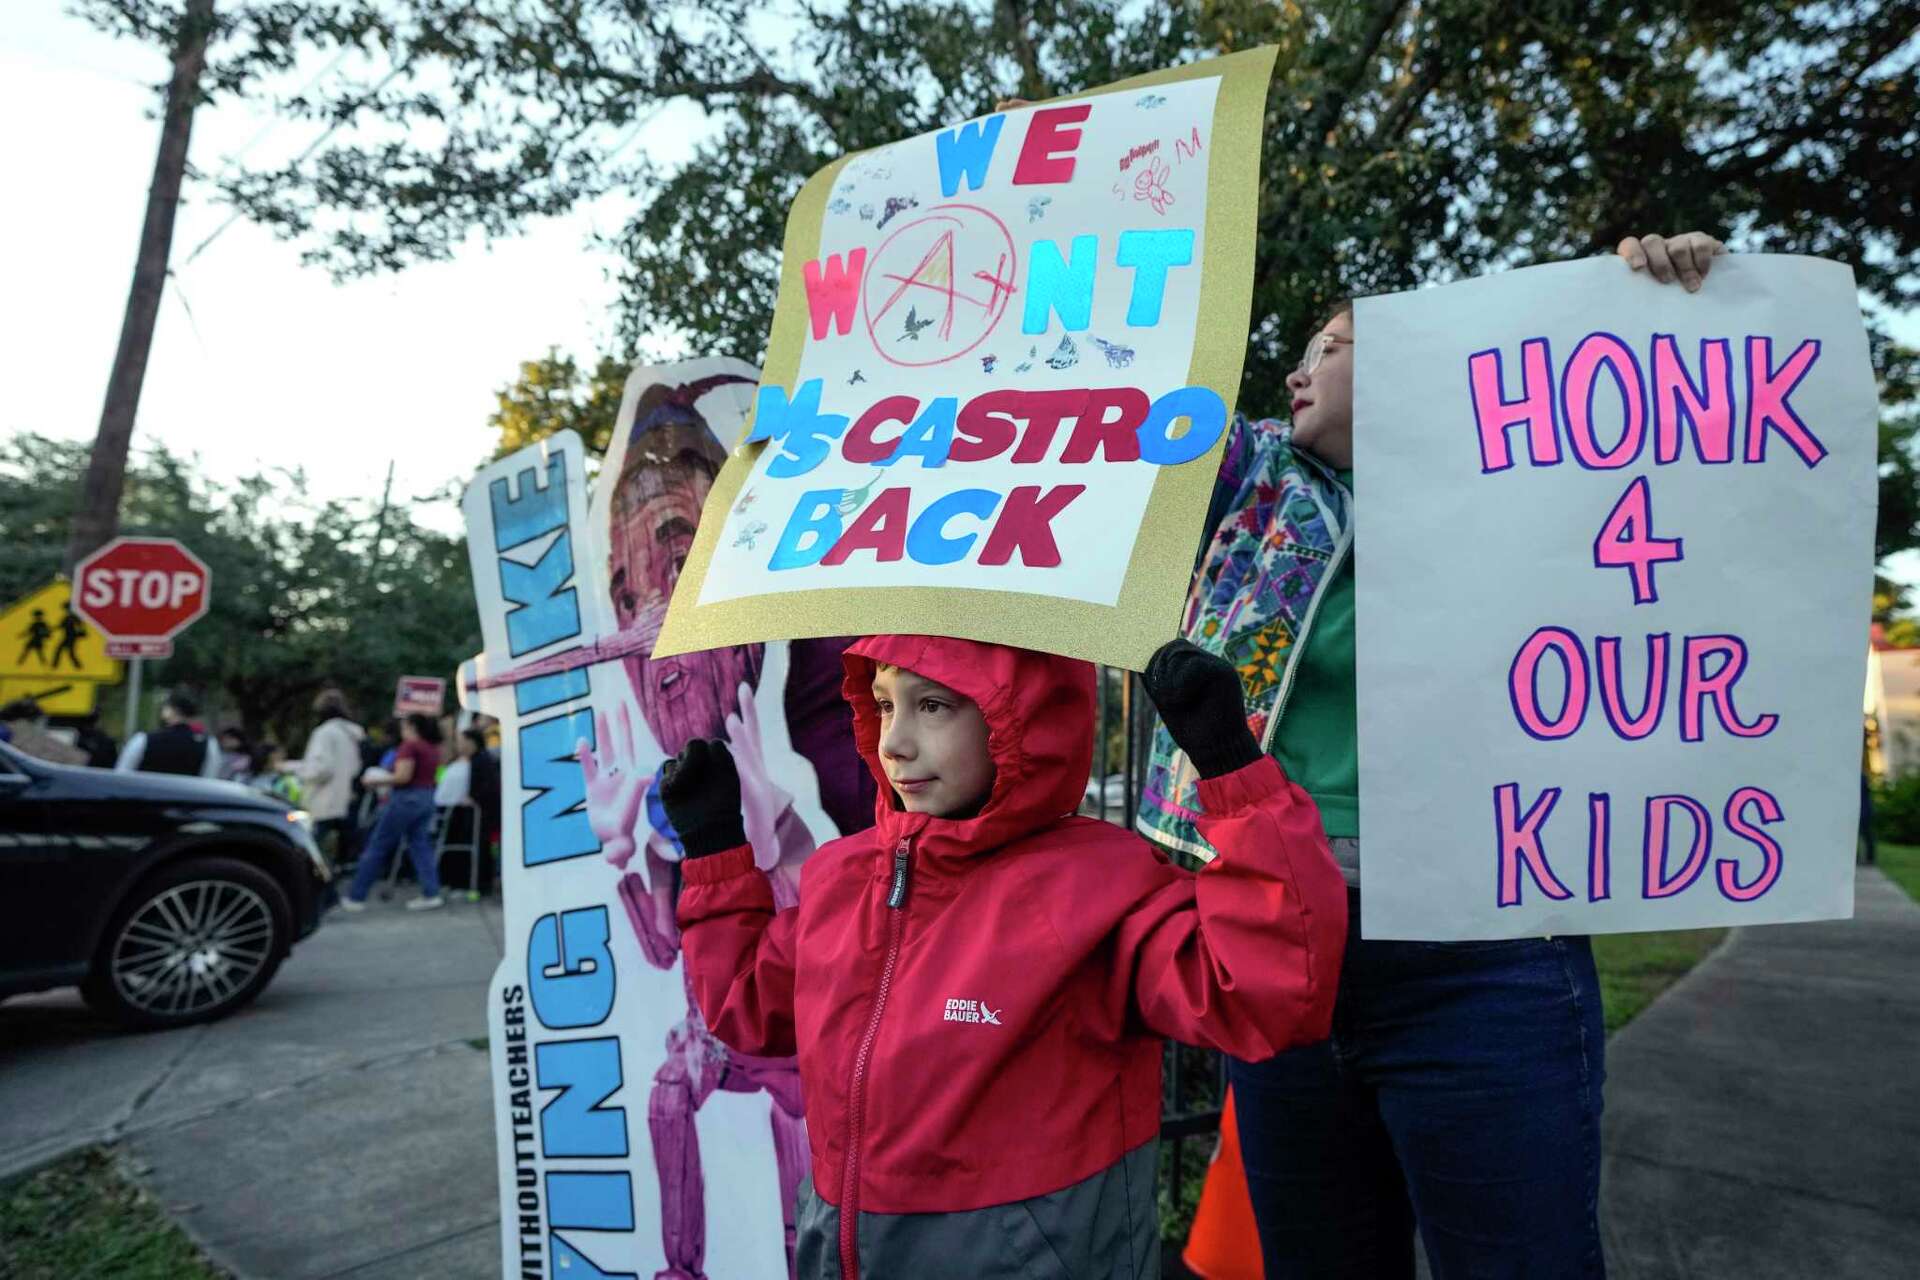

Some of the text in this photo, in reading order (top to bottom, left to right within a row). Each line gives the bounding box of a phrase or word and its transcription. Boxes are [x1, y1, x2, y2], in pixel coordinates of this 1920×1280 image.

[936, 105, 1092, 197] WE
[842, 387, 1227, 468] CASTRO
[1468, 333, 1828, 473] HONK
[767, 484, 1086, 571] BACK
[1593, 475, 1683, 605] 4
[84, 567, 201, 609] STOP
[490, 449, 602, 867] MIKE
[1508, 626, 1779, 742] OUR
[1493, 783, 1784, 908] KIDS
[943, 1009, 980, 1024] BAUER
[945, 998, 978, 1011] EDDIE
